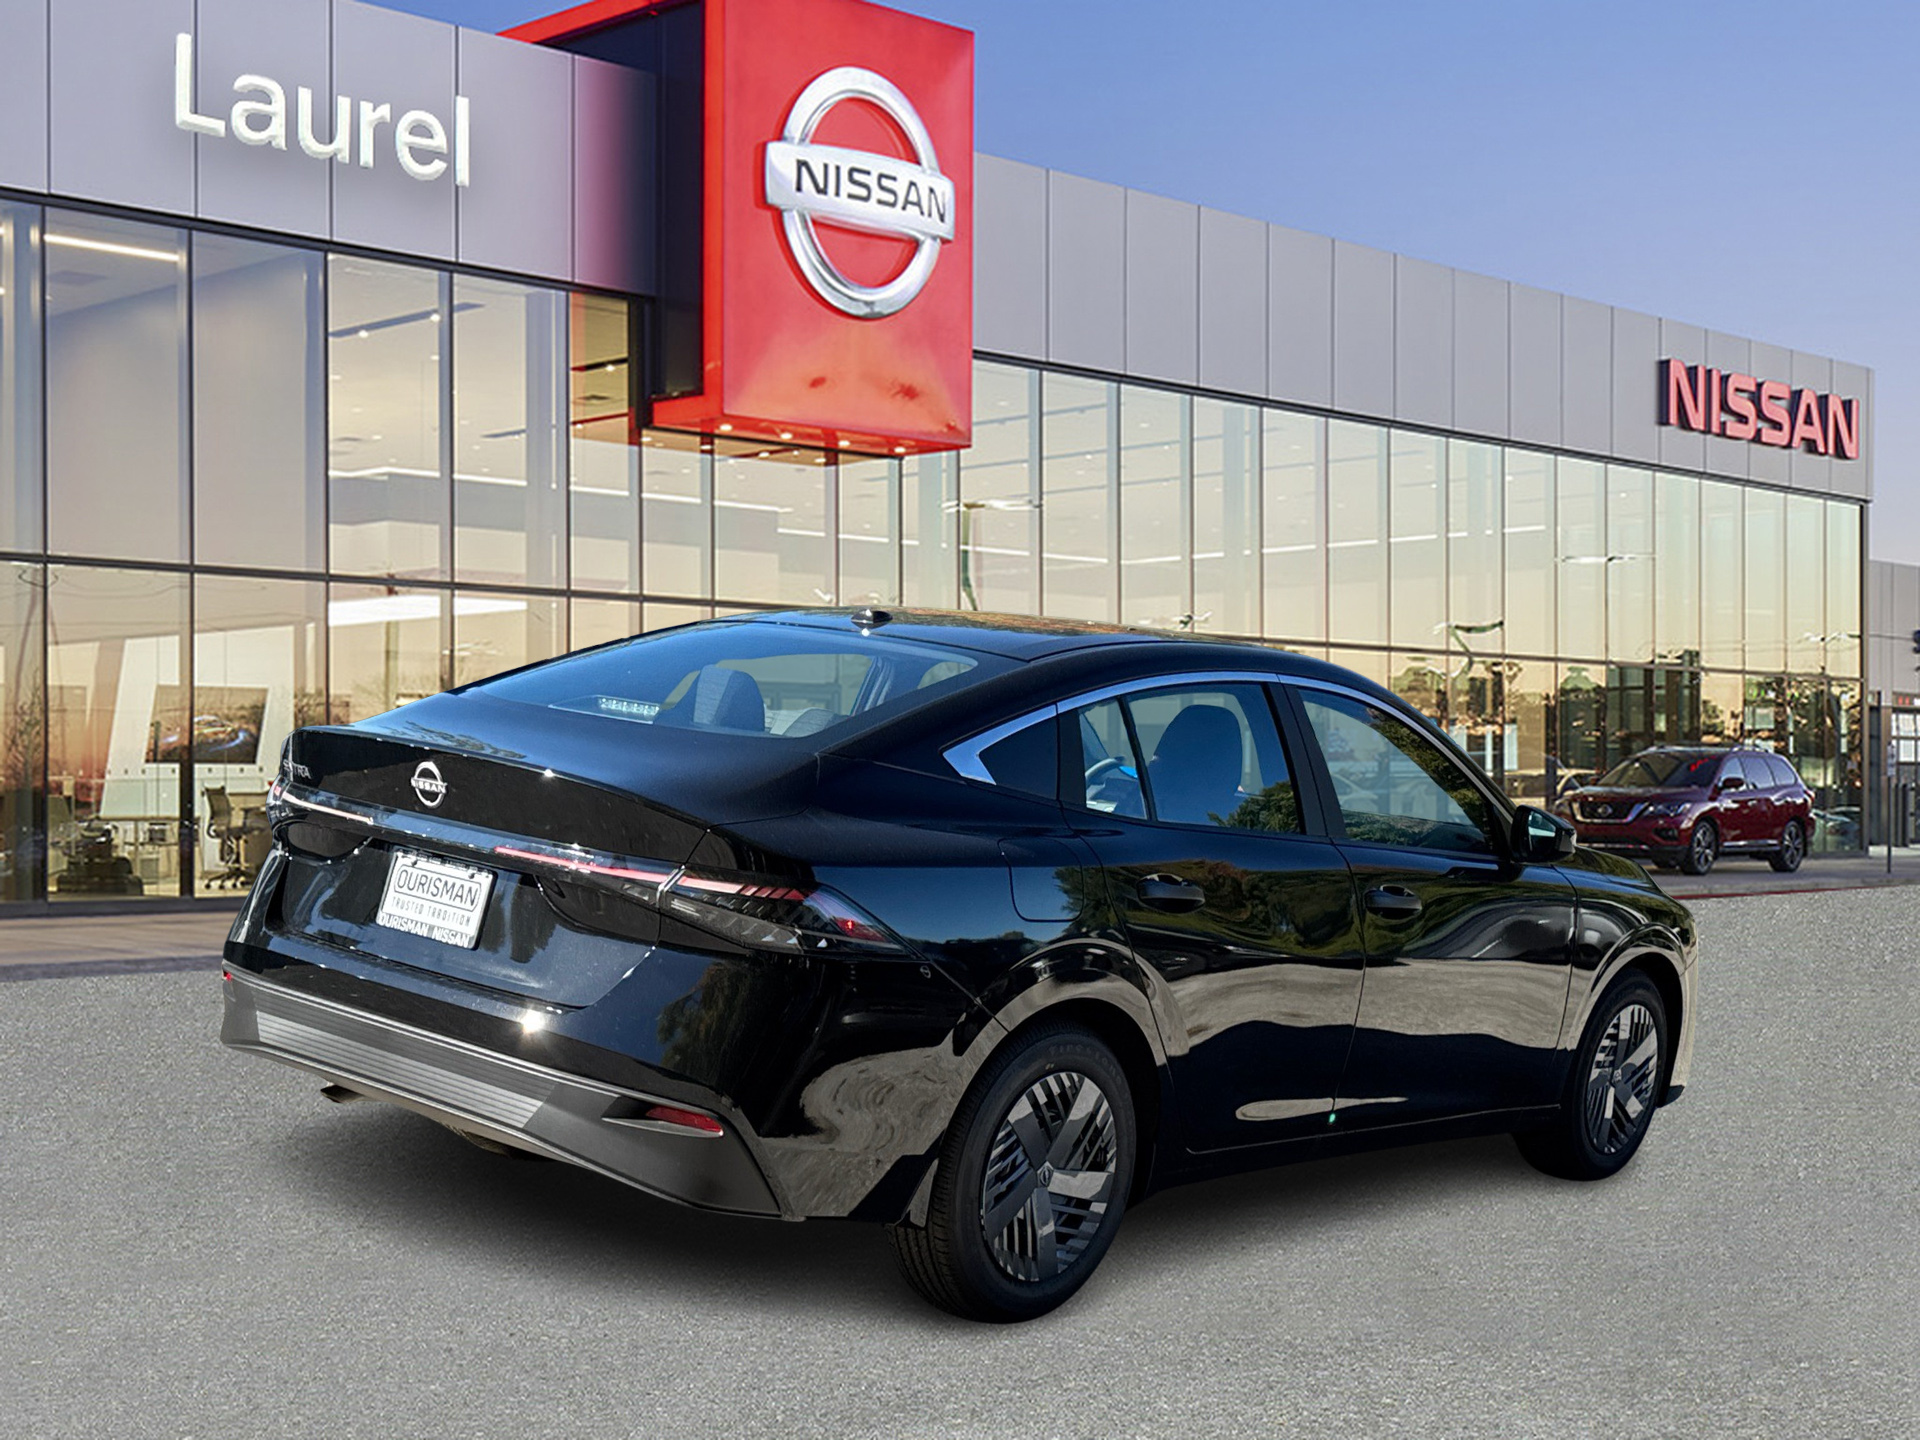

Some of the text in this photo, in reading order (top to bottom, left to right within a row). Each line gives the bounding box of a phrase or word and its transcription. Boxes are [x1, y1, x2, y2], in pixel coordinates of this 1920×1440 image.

[175, 32, 470, 188] Laurel
[795, 158, 946, 224] NISSAN
[1658, 357, 1860, 461] NISSAN
[411, 779, 448, 794] NISSAN
[391, 896, 425, 915] TRUSTED
[396, 869, 479, 907] OURISMAN
[380, 913, 471, 949] OURISMAN NISSAN
